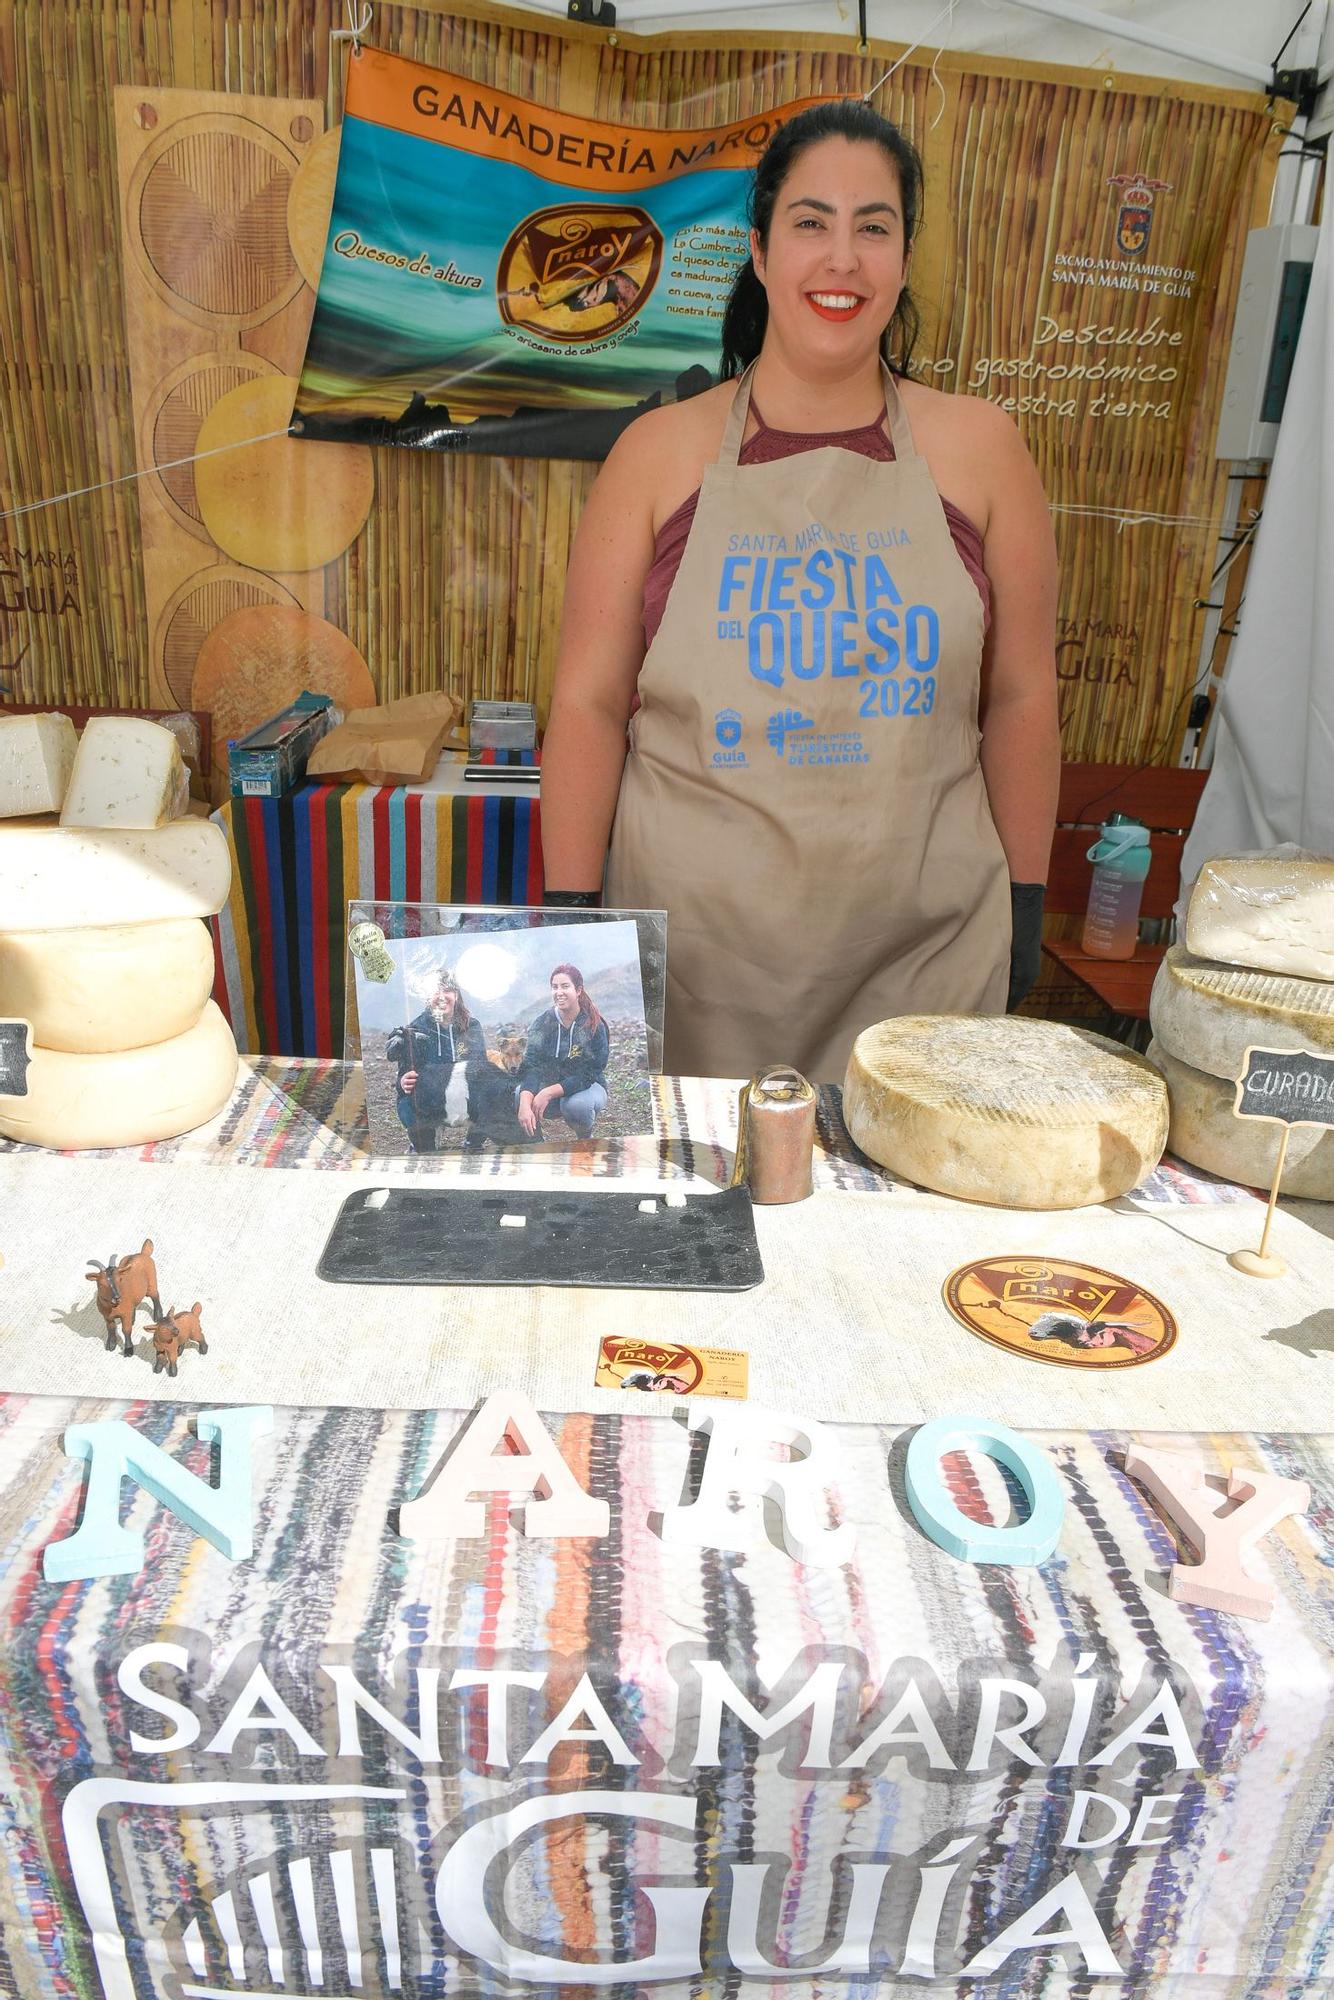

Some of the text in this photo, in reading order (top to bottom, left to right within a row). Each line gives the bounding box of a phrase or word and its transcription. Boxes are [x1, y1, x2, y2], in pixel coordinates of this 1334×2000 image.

[412, 84, 656, 174] GANADERÍA
[674, 238, 686, 249] La
[689, 237, 731, 253] Cumbre
[693, 224, 703, 233] lo
[706, 225, 726, 236] más
[728, 225, 747, 239] alto
[334, 232, 482, 289] Quesos de altura
[557, 232, 633, 270] naroy
[672, 251, 682, 262] el
[684, 256, 715, 268] queso
[717, 257, 729, 268] de
[1052, 269, 1192, 298] SANTA MARÍA DE GUÍA
[1184, 270, 1197, 281] DE
[666, 305, 704, 316] nuestra
[668, 288, 681, 296] en
[683, 290, 714, 302] cueva,
[564, 345, 578, 357] de
[580, 341, 608, 356] cabra
[609, 339, 617, 350] y
[618, 319, 640, 341] oveja
[1033, 316, 1185, 348] Descubre
[967, 354, 1179, 388] gastronómico
[1089, 392, 1172, 419] tierra
[728, 534, 788, 552] SANTA
[839, 533, 860, 552] DE
[717, 548, 903, 612] FIESTA
[717, 604, 940, 689] DEL QUESO
[858, 675, 936, 719] 2023
[788, 753, 870, 766] DE CANARIAS
[1018, 1281, 1117, 1323] naroy
[623, 1350, 679, 1375] naroy
[117, 1641, 1200, 1771] SANTA MARÍA
[1060, 1789, 1184, 1850] DE
[434, 1789, 1126, 1985] GUÍA
